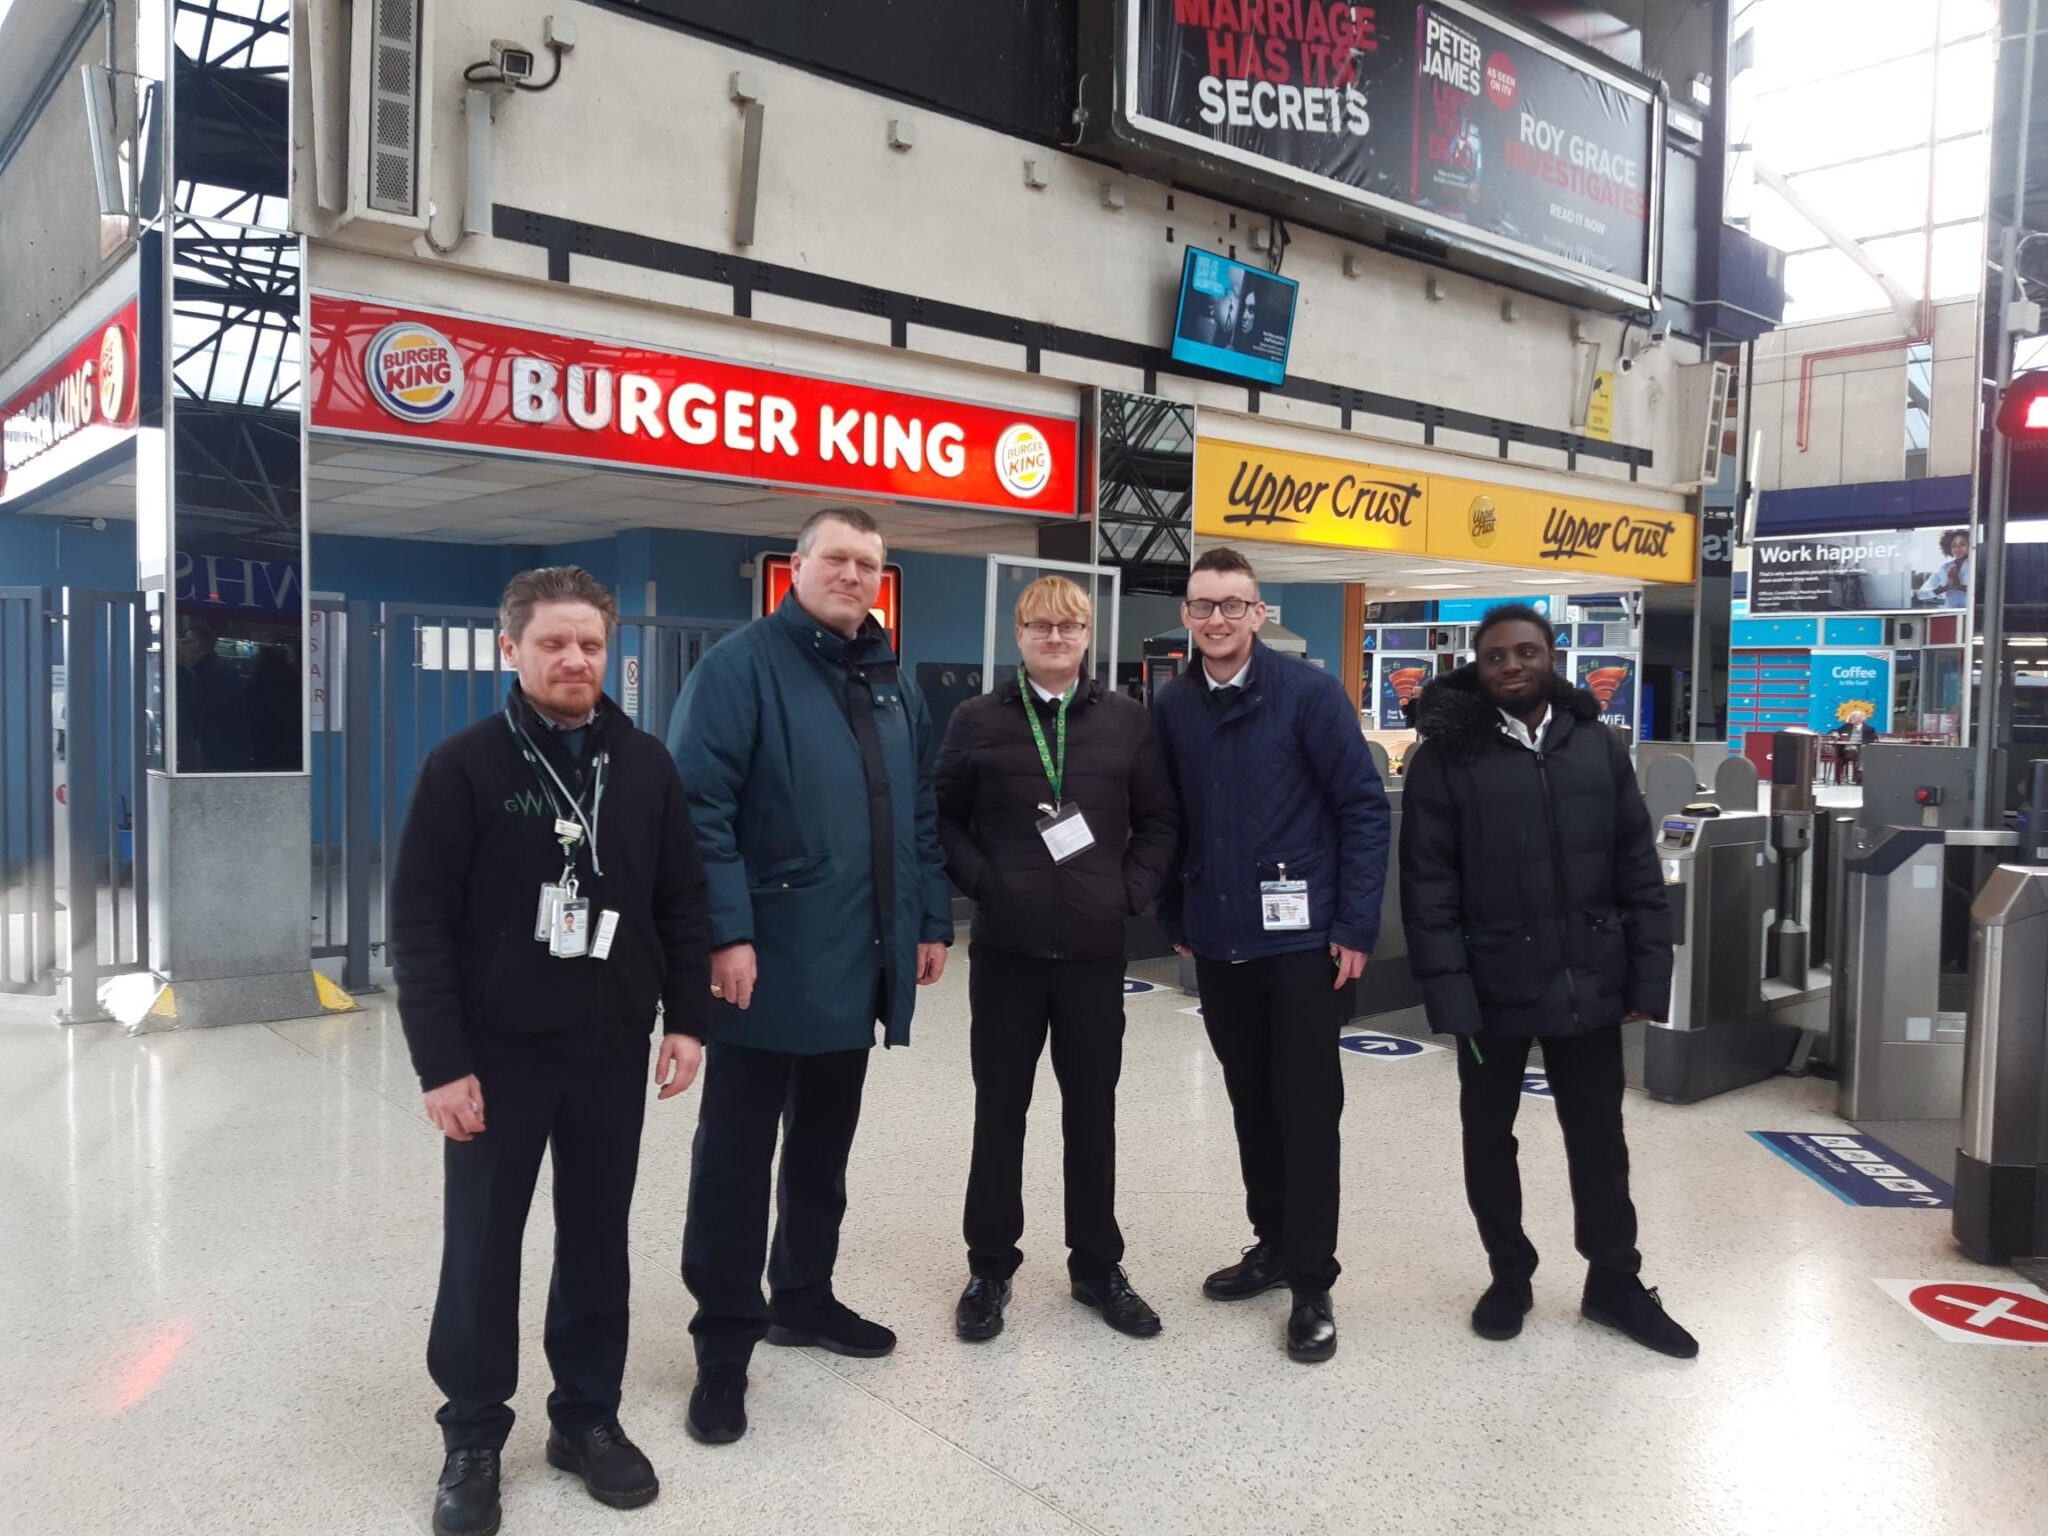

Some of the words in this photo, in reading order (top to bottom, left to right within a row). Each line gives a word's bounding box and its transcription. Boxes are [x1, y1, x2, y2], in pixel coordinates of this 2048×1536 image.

[1174, 0, 1378, 51] MARRIAGE
[1427, 18, 1481, 71] PETER
[1207, 30, 1290, 83] HAS
[1302, 43, 1357, 89] ITS
[1423, 47, 1481, 96] JAMES
[1487, 67, 1497, 79] AS
[1497, 71, 1516, 88] SEEN
[1198, 75, 1370, 136] SECRETS
[1490, 79, 1501, 92] ON
[1520, 112, 1565, 156] ROY
[1569, 135, 1637, 188] GRACE
[1550, 203, 1574, 224] READ
[1575, 213, 1583, 228] IT
[1584, 217, 1606, 236] NOW
[382, 347, 448, 370] BURGER
[384, 362, 452, 393] KING
[54, 358, 94, 442] KING
[512, 356, 800, 459] BURGER
[819, 404, 966, 478] KING
[1007, 441, 1043, 460] BURGER
[1008, 452, 1046, 477] KING
[1224, 461, 1330, 527] Upper
[1332, 474, 1422, 527] Crust
[1540, 507, 1612, 560] Upper
[1612, 515, 1676, 558] Crust
[1760, 545, 1812, 563] Work
[1816, 542, 1901, 564] happier.
[1832, 666, 1877, 679] Coffee
[1597, 714, 1625, 725] WiFi
